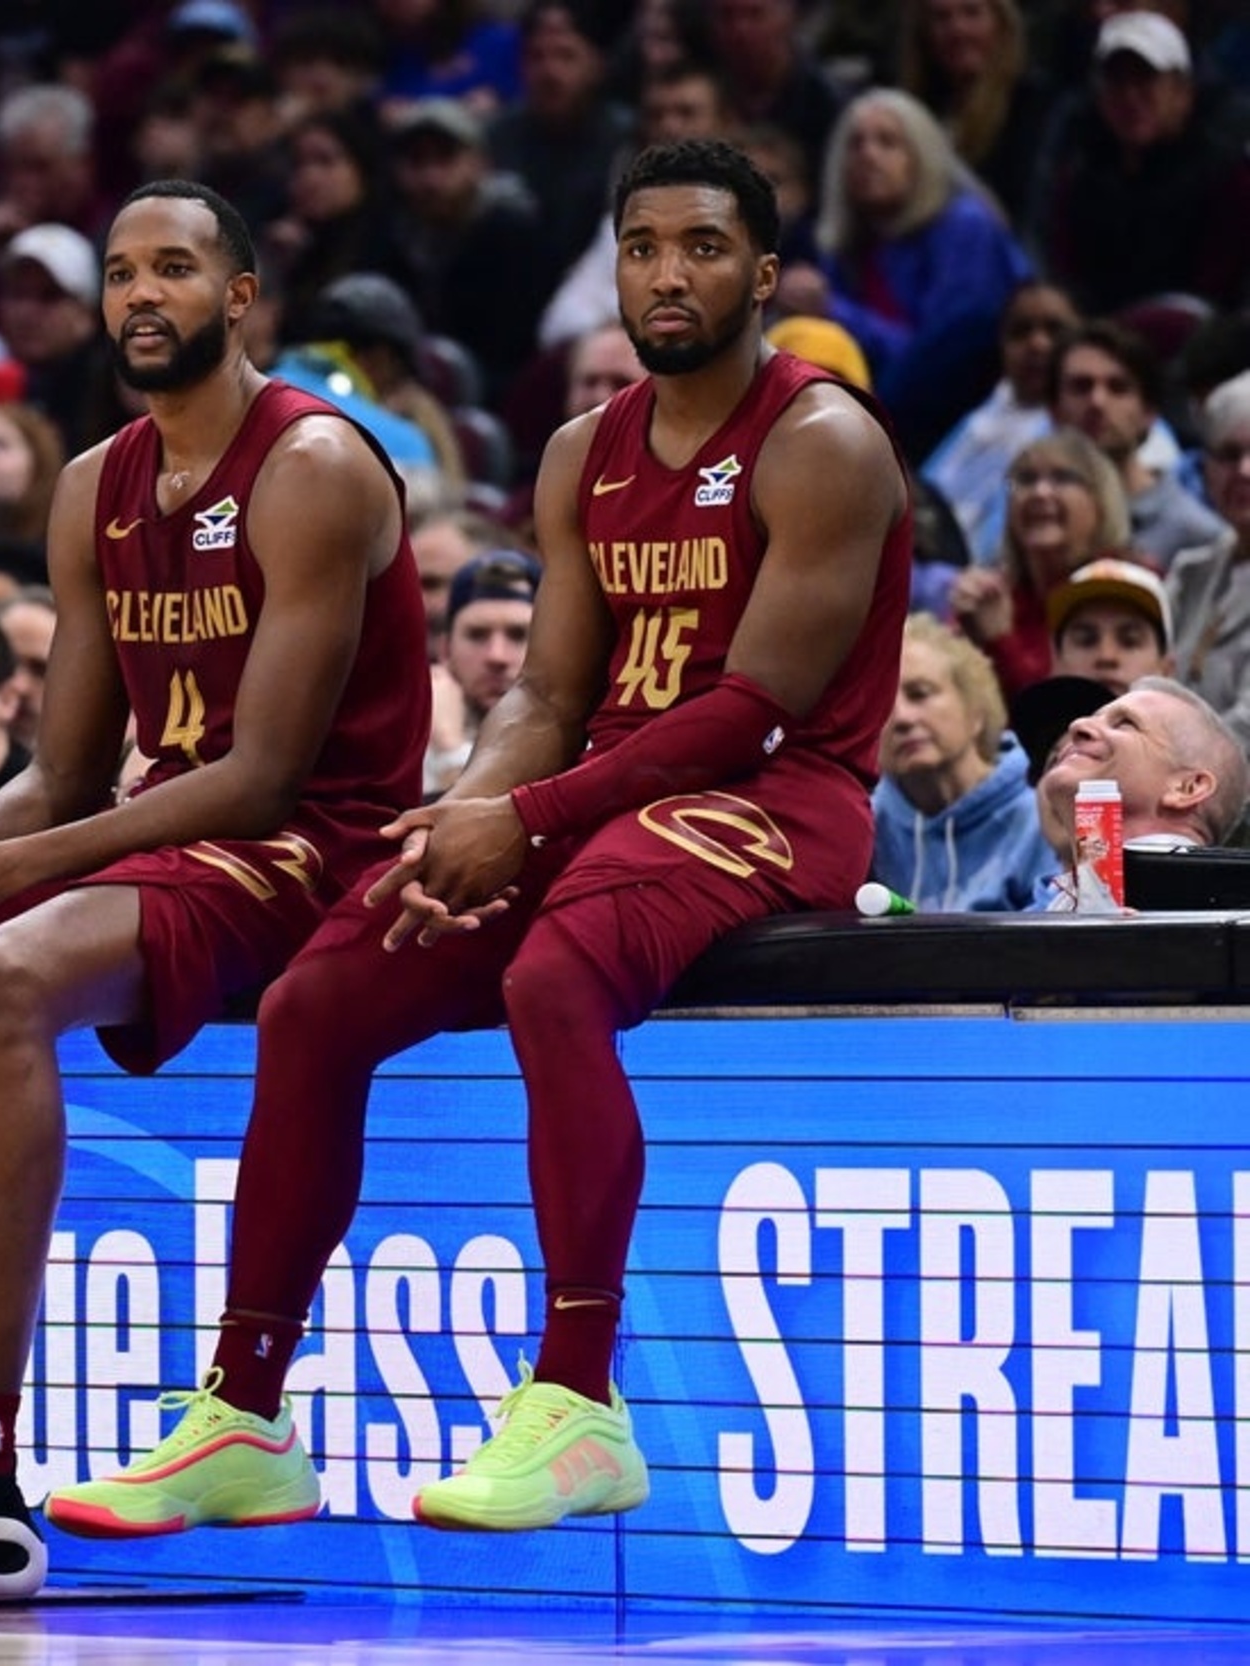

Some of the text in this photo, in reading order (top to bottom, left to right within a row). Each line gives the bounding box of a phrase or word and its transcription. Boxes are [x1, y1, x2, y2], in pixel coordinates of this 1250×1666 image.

[616, 607, 699, 710] 45
[159, 668, 206, 766] 4
[717, 1161, 1250, 1564] STREA
